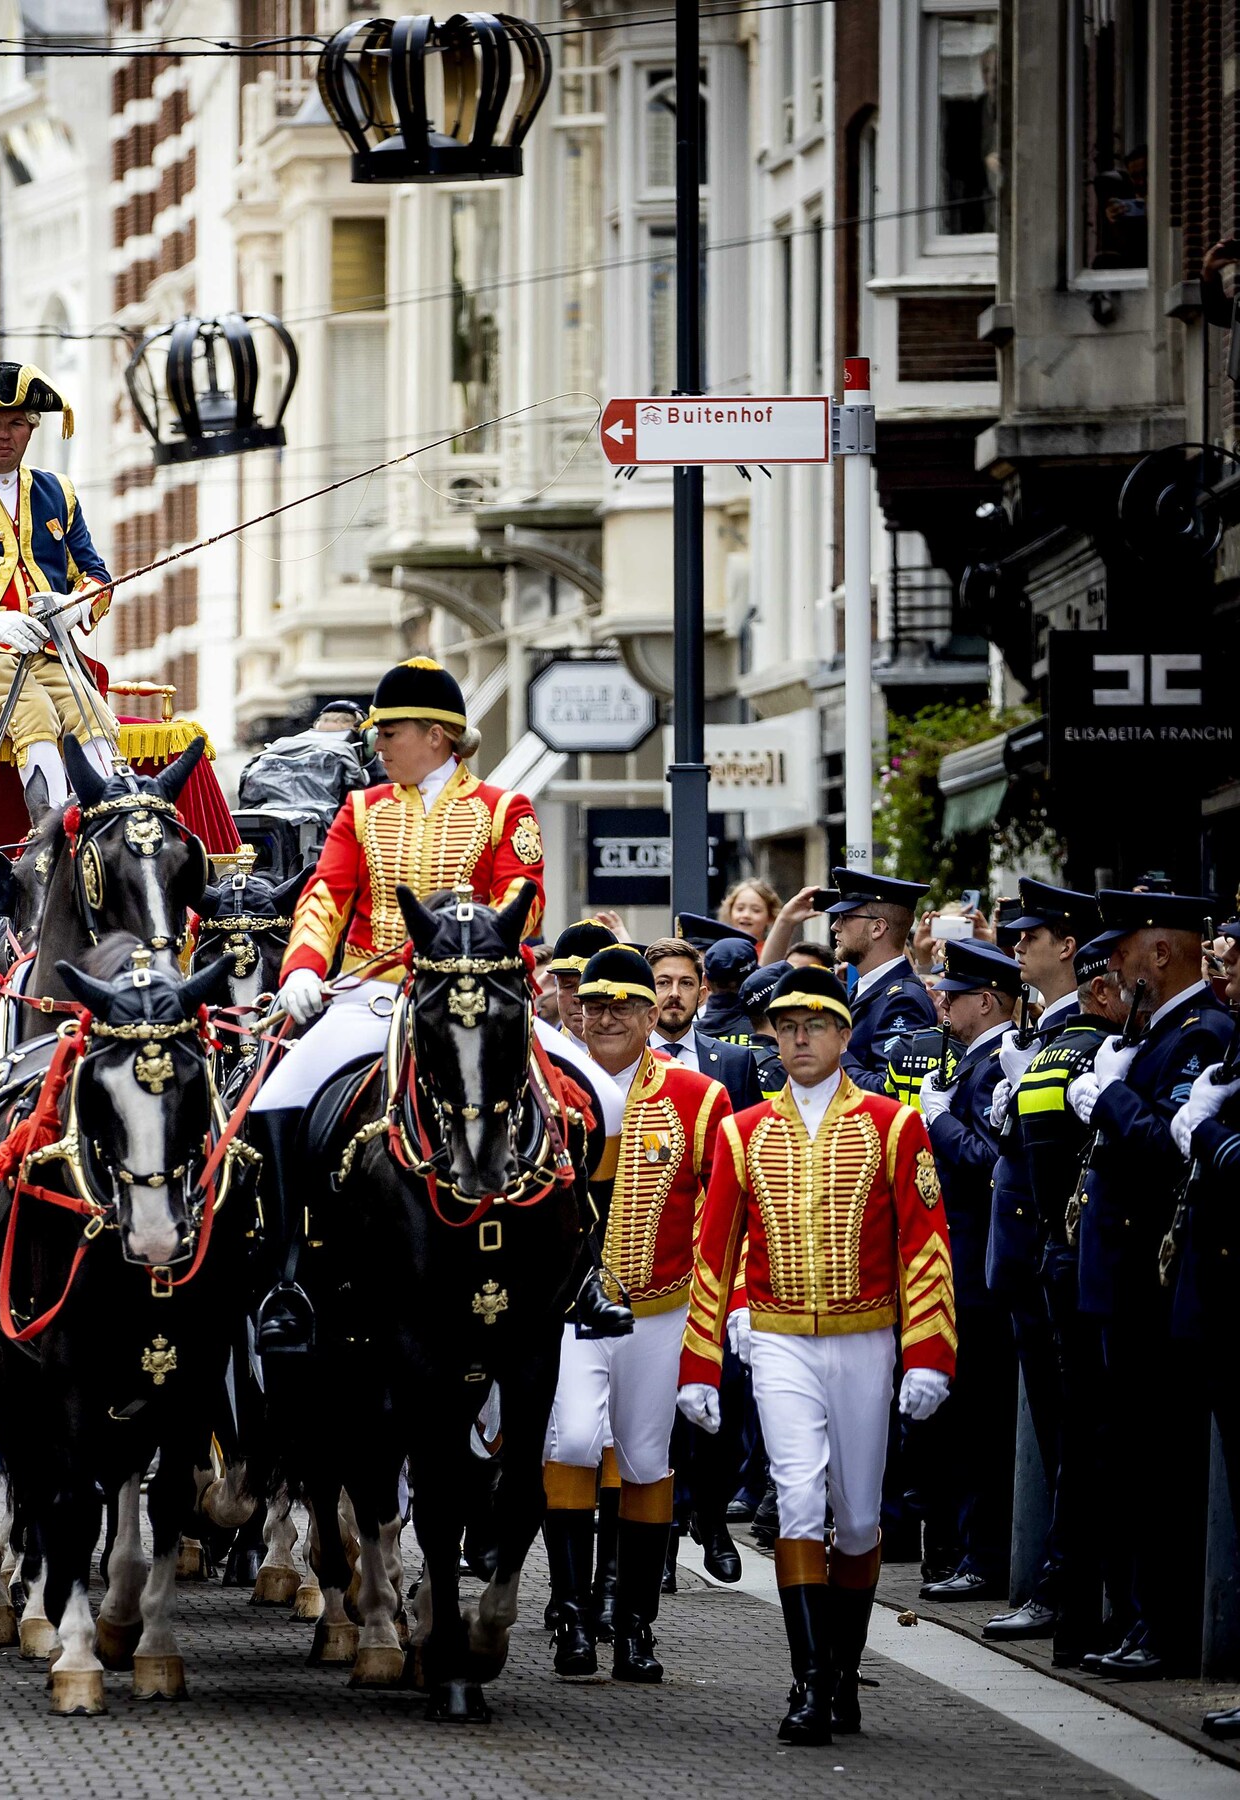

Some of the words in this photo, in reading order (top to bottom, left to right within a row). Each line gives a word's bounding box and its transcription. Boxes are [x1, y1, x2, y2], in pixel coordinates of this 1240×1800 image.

[667, 406, 773, 424] Buitenhof
[1064, 726, 1155, 741] ELISABETTA
[1159, 726, 1233, 741] FRANCHI
